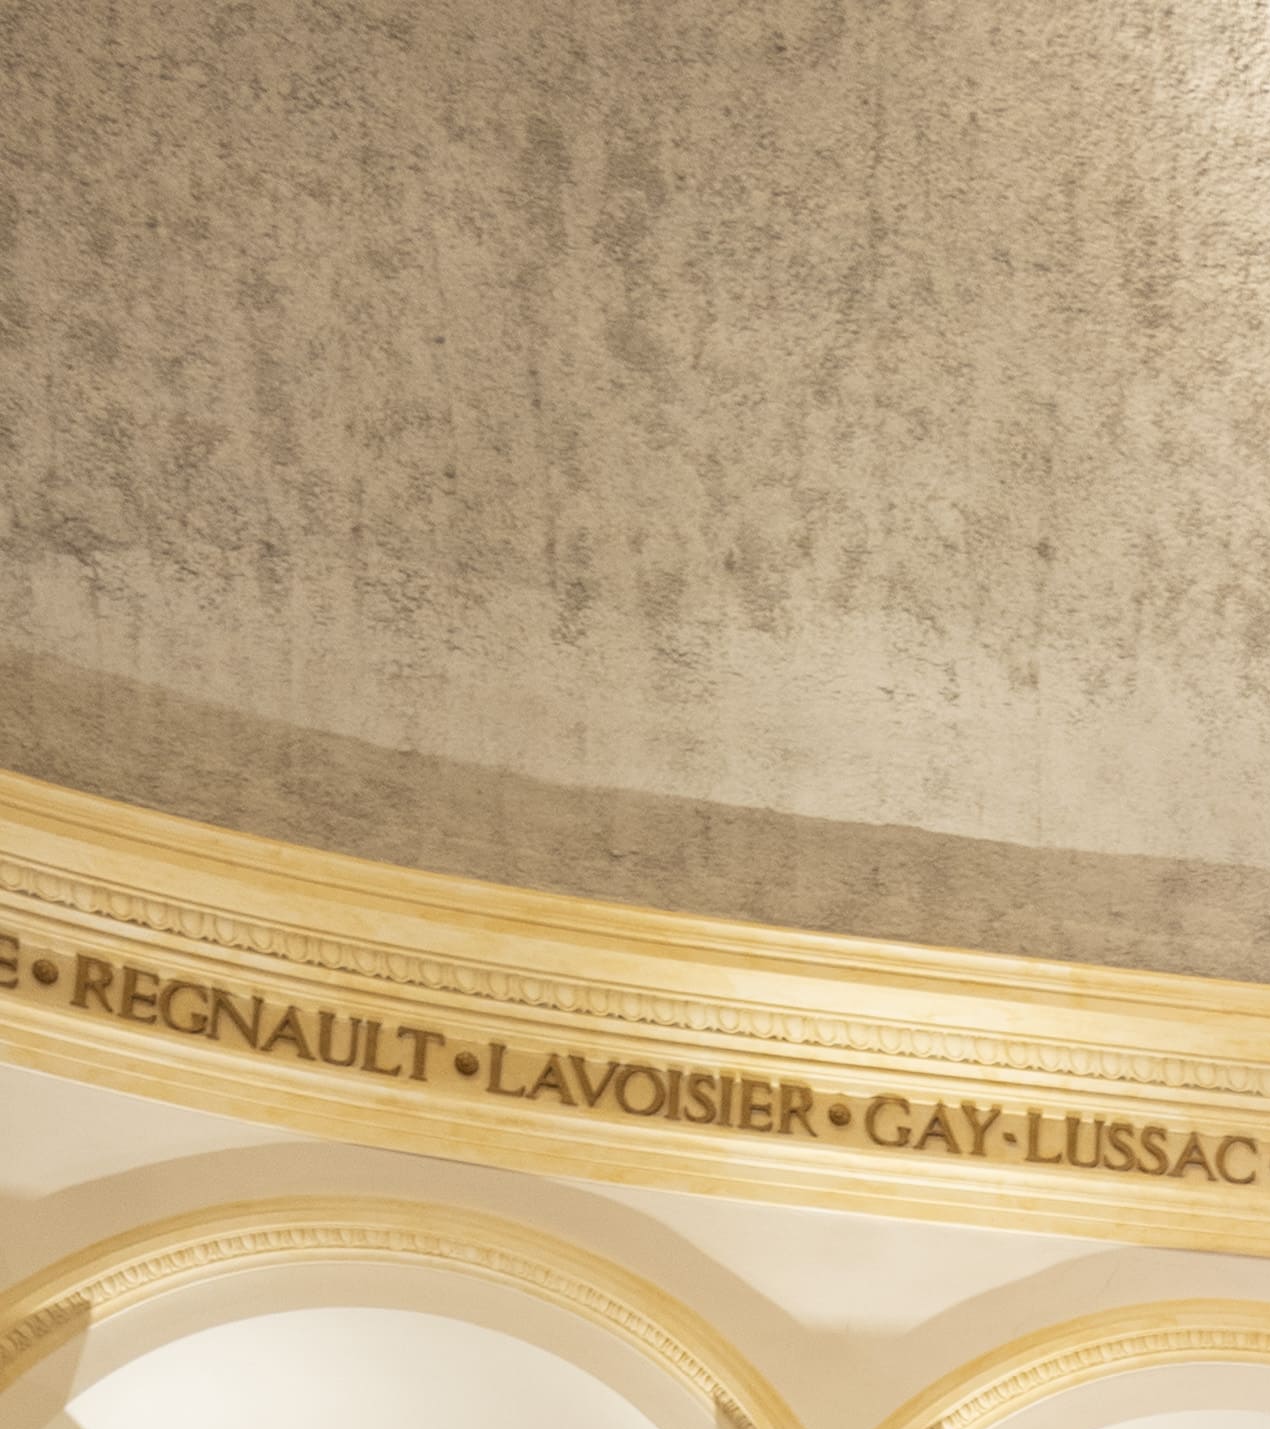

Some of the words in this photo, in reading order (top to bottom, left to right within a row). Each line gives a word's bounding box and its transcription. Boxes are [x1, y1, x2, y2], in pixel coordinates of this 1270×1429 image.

[70, 953, 447, 1083] REGNAULT
[486, 1044, 820, 1138] LAVOISIER
[864, 1095, 1257, 1186] GAY-LUSSAC
